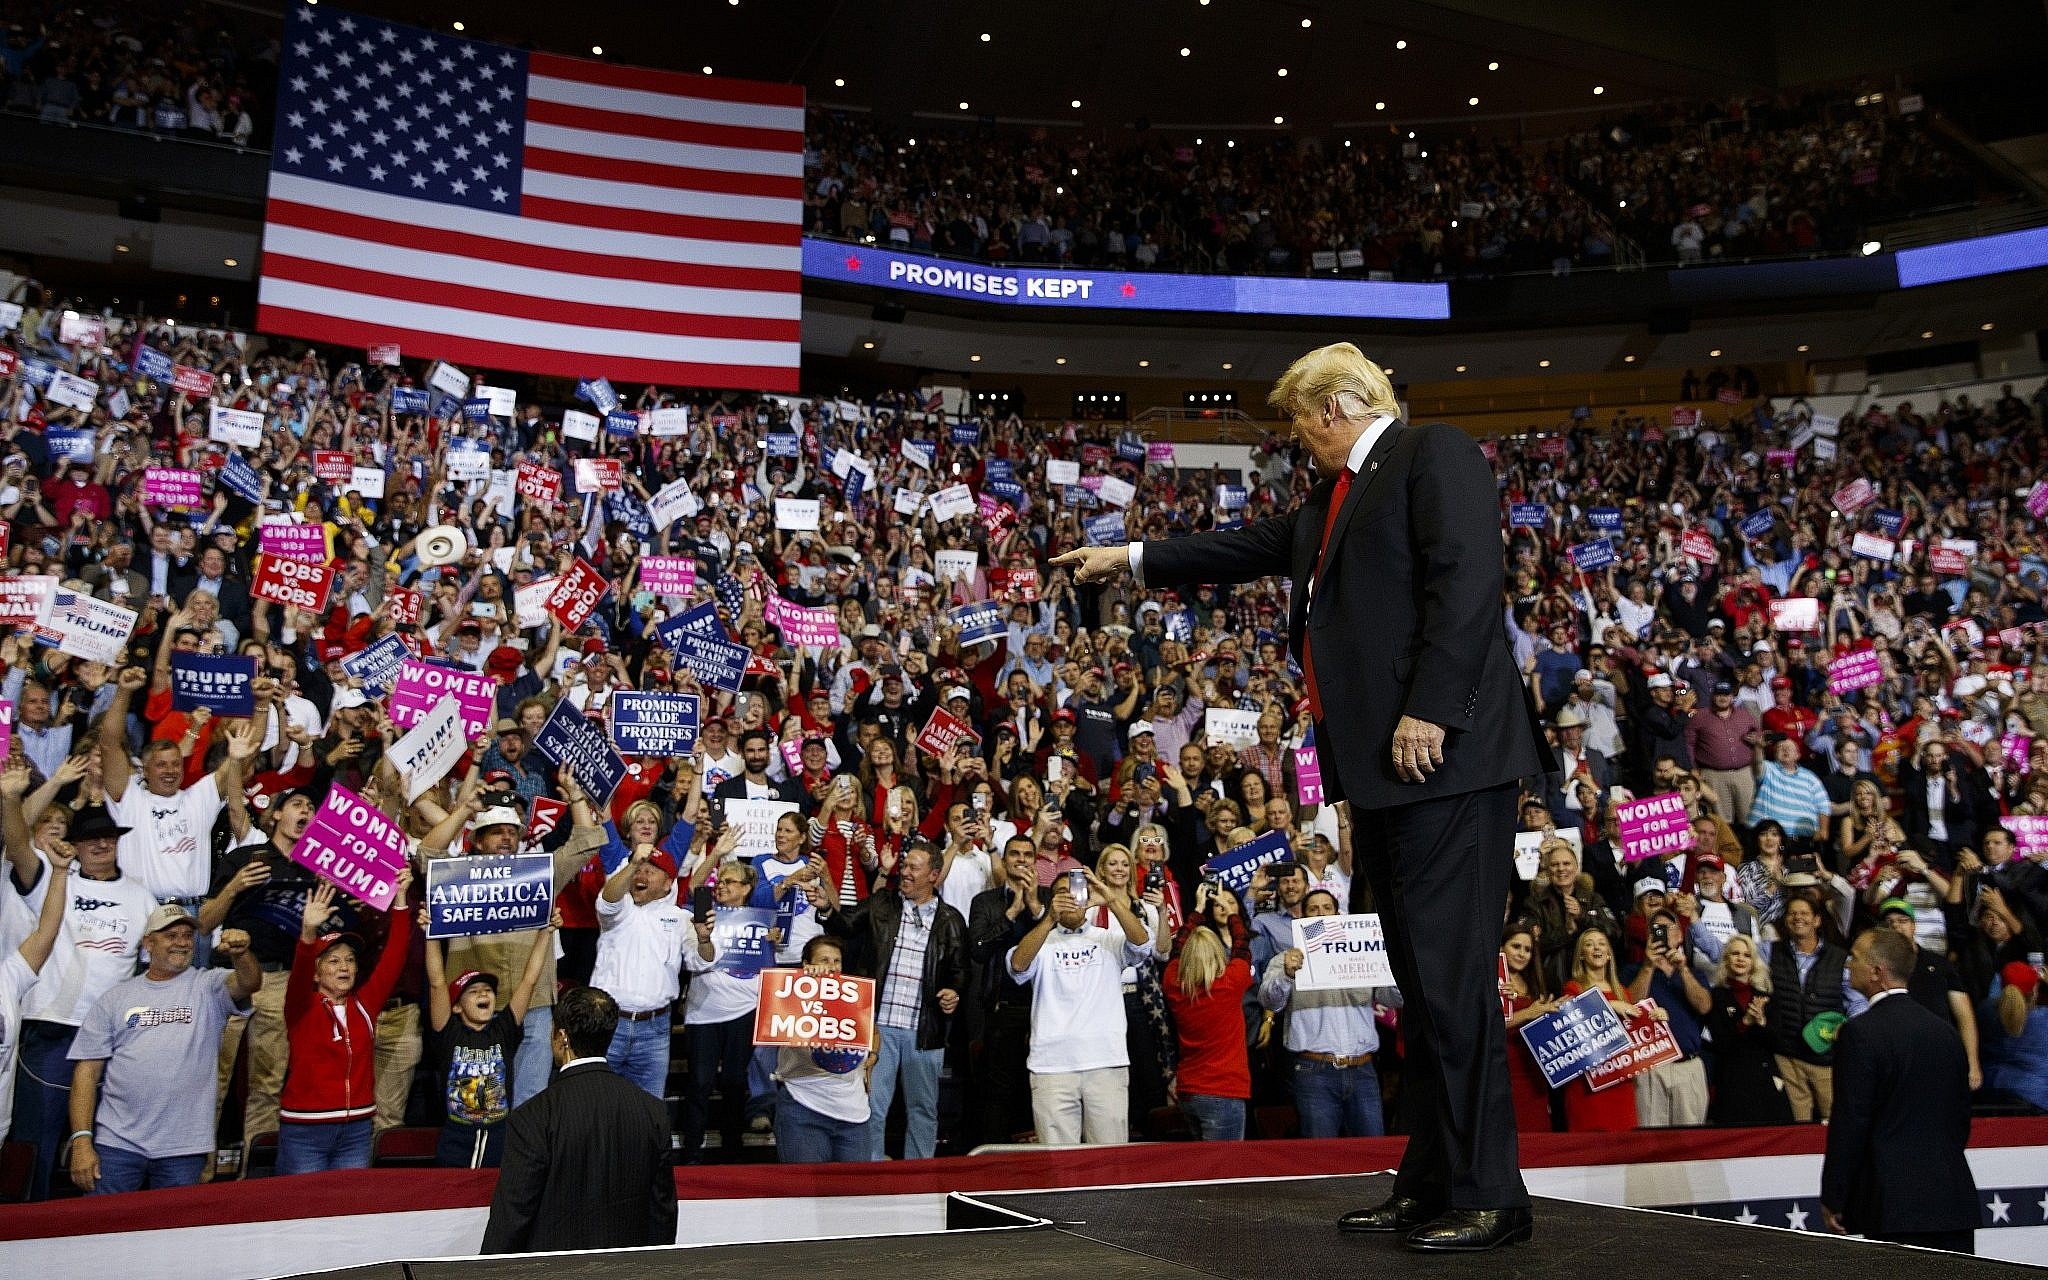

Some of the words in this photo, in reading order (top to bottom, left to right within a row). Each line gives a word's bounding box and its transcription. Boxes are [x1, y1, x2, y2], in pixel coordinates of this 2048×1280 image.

[890, 261, 1018, 296] PROMISES
[1027, 278, 1094, 299] KEPT
[146, 470, 201, 483] WOMEN
[520, 464, 535, 477] GET
[535, 467, 560, 482] OUT
[160, 483, 183, 492] FOR
[517, 479, 554, 500] VOTE
[147, 492, 199, 505] TRUMP
[263, 527, 323, 540] TRUMP
[280, 542, 305, 551] FOR
[268, 559, 324, 583] JOBS
[641, 558, 695, 572] WOMEN
[658, 572, 679, 581] FOR
[1013, 572, 1034, 581] OUT
[261, 581, 317, 607] MOBS
[551, 566, 585, 609] MOBS
[643, 582, 692, 595] TRUMP
[389, 593, 406, 620] VO
[567, 582, 600, 624] JOBS
[66, 612, 128, 638] TRUMP
[779, 605, 836, 624] WOMEN
[956, 608, 999, 625] TRUMP
[785, 630, 837, 645] TRUMP
[795, 622, 818, 633] FOR
[351, 639, 400, 673] PROMISES
[685, 636, 744, 661] PROMISES
[695, 649, 728, 665] MADE
[680, 655, 737, 680] PROMISES
[1826, 650, 1877, 672] WOMEN
[1842, 665, 1863, 677] FOR
[174, 668, 249, 685] TRUMP
[402, 663, 497, 699] WOMEN
[1833, 670, 1882, 691] TRUMP
[180, 681, 241, 694] PENCE
[622, 698, 693, 714] PROMISES
[637, 711, 680, 724] MADE
[406, 715, 455, 769] TRUMP
[580, 723, 610, 752] KEPT
[621, 726, 693, 741] PROMISES
[559, 715, 615, 780] PROMISES
[637, 738, 677, 751] KEPT
[746, 808, 774, 818] KEEP
[1617, 796, 1685, 823] WOMEN
[328, 789, 412, 861] WOMEN
[533, 808, 559, 841] VO
[1642, 818, 1670, 833] FOR
[341, 833, 378, 863] FOR
[1627, 831, 1690, 856] TRUMP
[302, 837, 390, 899] TRUMP
[470, 866, 512, 880] MAKE
[1218, 847, 1286, 884] TRUMP
[430, 882, 550, 905] AMERICA
[442, 907, 483, 923] SAFE
[486, 904, 538, 921] AGAIN
[1055, 945, 1098, 960] TRUMP
[1322, 940, 1386, 954] TRUM
[1328, 961, 1388, 975] AMERICA
[774, 975, 860, 1004] JOBS
[770, 1014, 858, 1041] MOBS
[1552, 1008, 1585, 1032] MAKE
[1537, 1009, 1617, 1063] AMERICA
[1544, 1042, 1593, 1076] STRONG
[1591, 1024, 1623, 1052] AGAIN
[1589, 1054, 1634, 1080] PROUD
[1633, 1038, 1673, 1064] AGAIN
